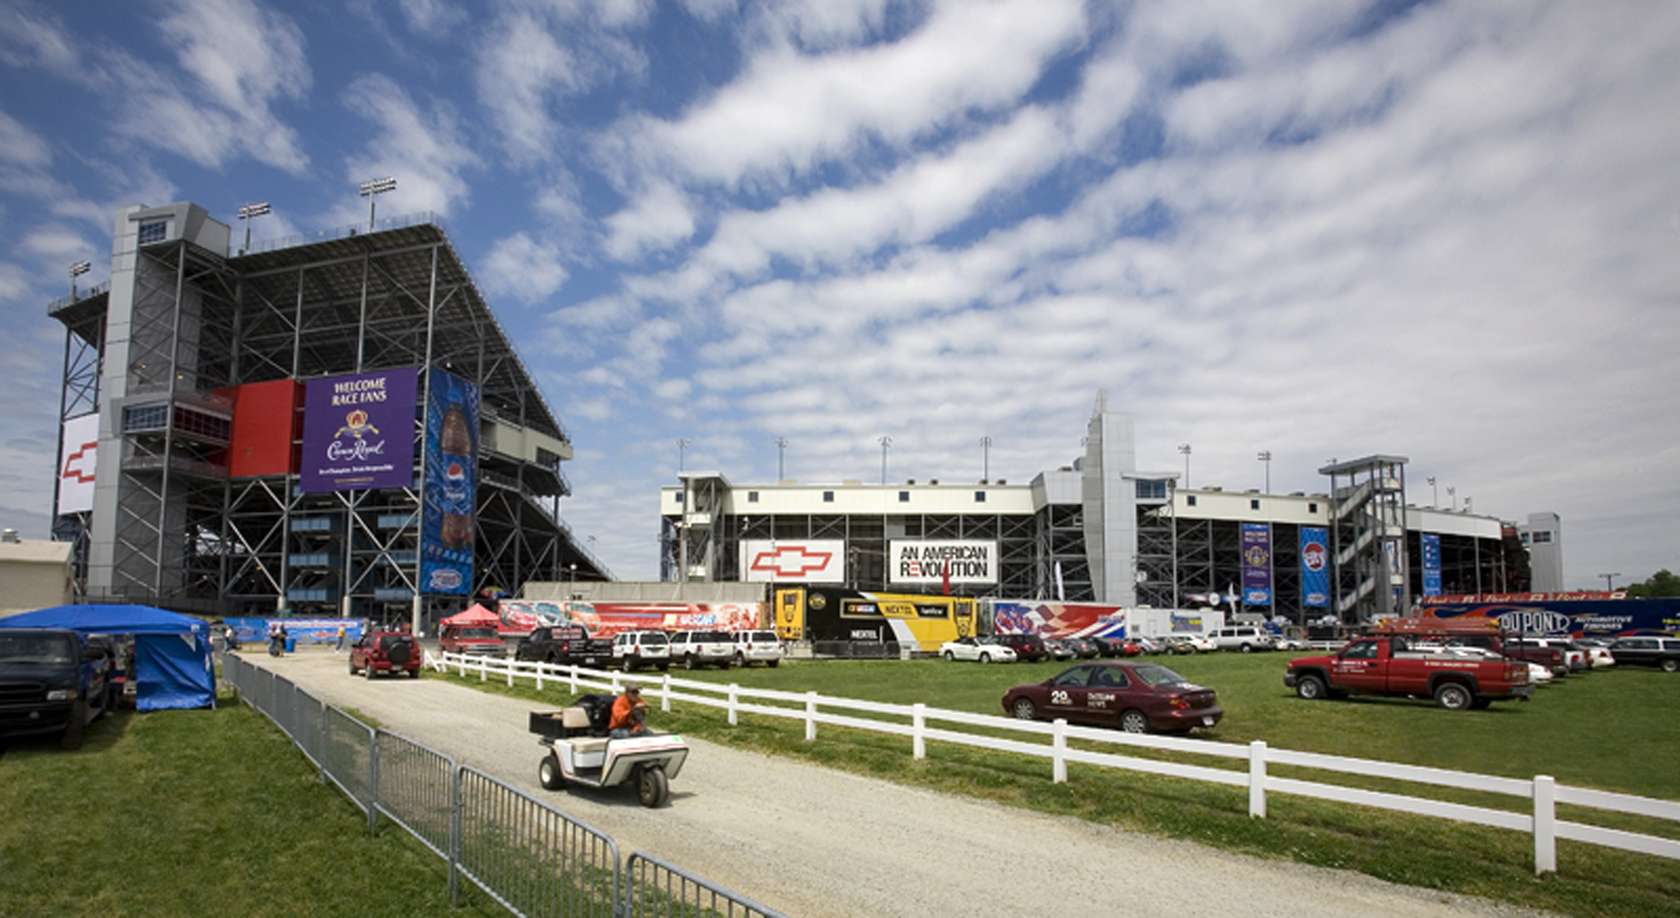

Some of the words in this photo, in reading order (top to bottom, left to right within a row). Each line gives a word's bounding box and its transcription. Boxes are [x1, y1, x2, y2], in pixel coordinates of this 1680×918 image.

[334, 377, 386, 394] WELCOME
[332, 393, 359, 406] RACE
[360, 390, 387, 403] FANS
[900, 546, 919, 560] AN
[922, 546, 988, 560] AMERICAN
[900, 561, 988, 577] REVOLUTION
[851, 629, 877, 639] NEXTEL
